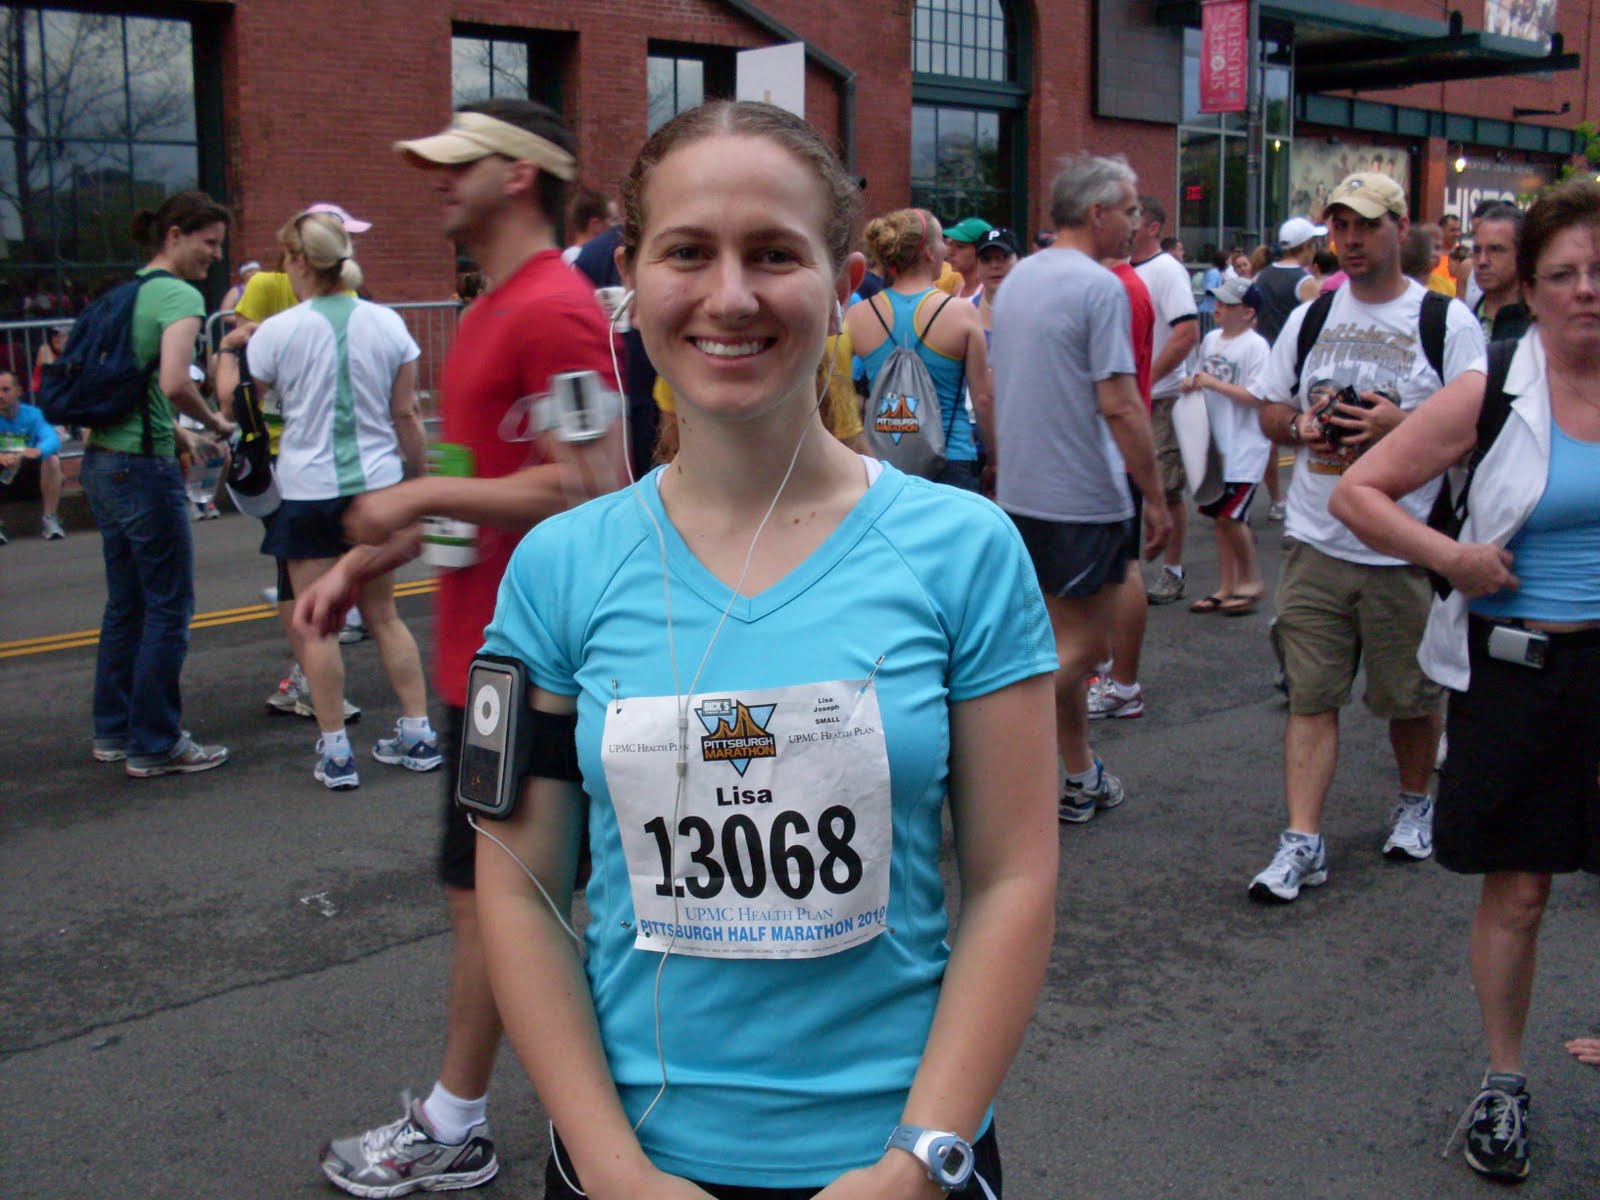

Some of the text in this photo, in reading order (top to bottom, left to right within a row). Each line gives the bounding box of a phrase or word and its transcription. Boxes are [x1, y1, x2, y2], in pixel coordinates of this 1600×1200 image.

[1227, 5, 1242, 88] MUSEUM
[1210, 23, 1225, 90] SPORTS
[813, 704, 840, 713] Joseph
[815, 716, 840, 724] SMALL
[703, 736, 773, 750] PITTSBURGH
[788, 732, 819, 744] UPMC
[608, 744, 636, 754] UPMC
[704, 745, 775, 759] MARATHON
[716, 785, 773, 806] Lisa
[643, 804, 863, 900] 13068
[685, 907, 735, 921] UPMC
[640, 905, 886, 942] PITTSBURGH HALF MARATHON 2010
